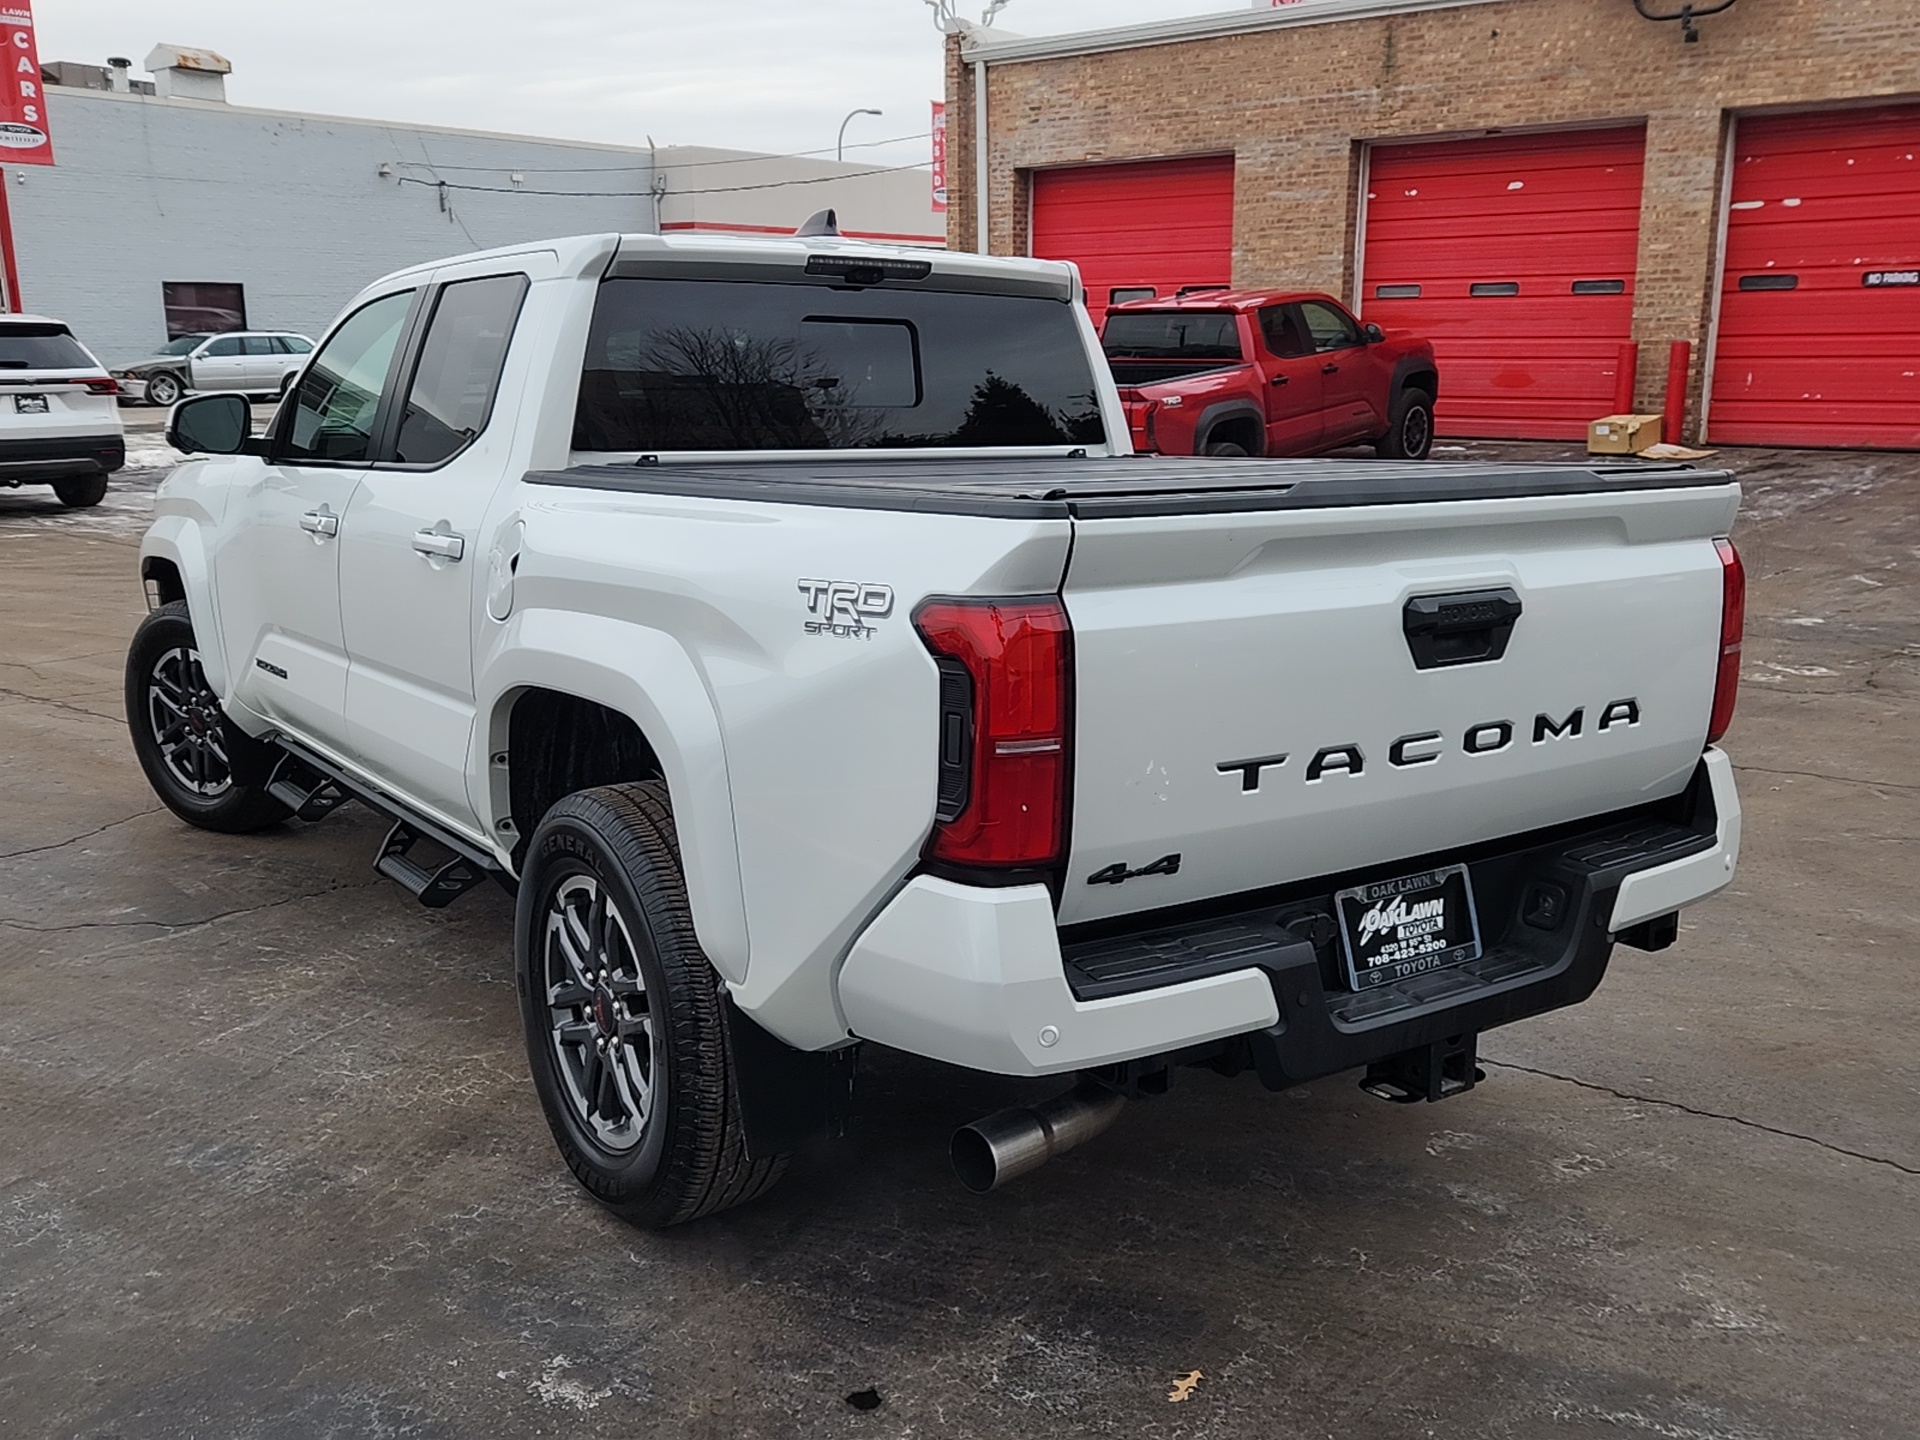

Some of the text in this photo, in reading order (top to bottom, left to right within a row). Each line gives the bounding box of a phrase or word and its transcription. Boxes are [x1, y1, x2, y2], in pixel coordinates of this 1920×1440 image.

[2, 7, 30, 17] LAWN
[13, 31, 38, 122] CARS
[1868, 272, 1881, 284] NO
[798, 579, 895, 626] TRD
[1441, 603, 1497, 622] TOYOTA
[804, 621, 878, 641] SPORT
[1215, 697, 1641, 796] TACOMA
[541, 834, 604, 876] GENERAL
[1371, 875, 1431, 898] OAK LAWN
[1403, 919, 1439, 937] TOYOTA
[1367, 939, 1447, 967] 708-423-5200
[1394, 955, 1441, 977] TOYOTA
